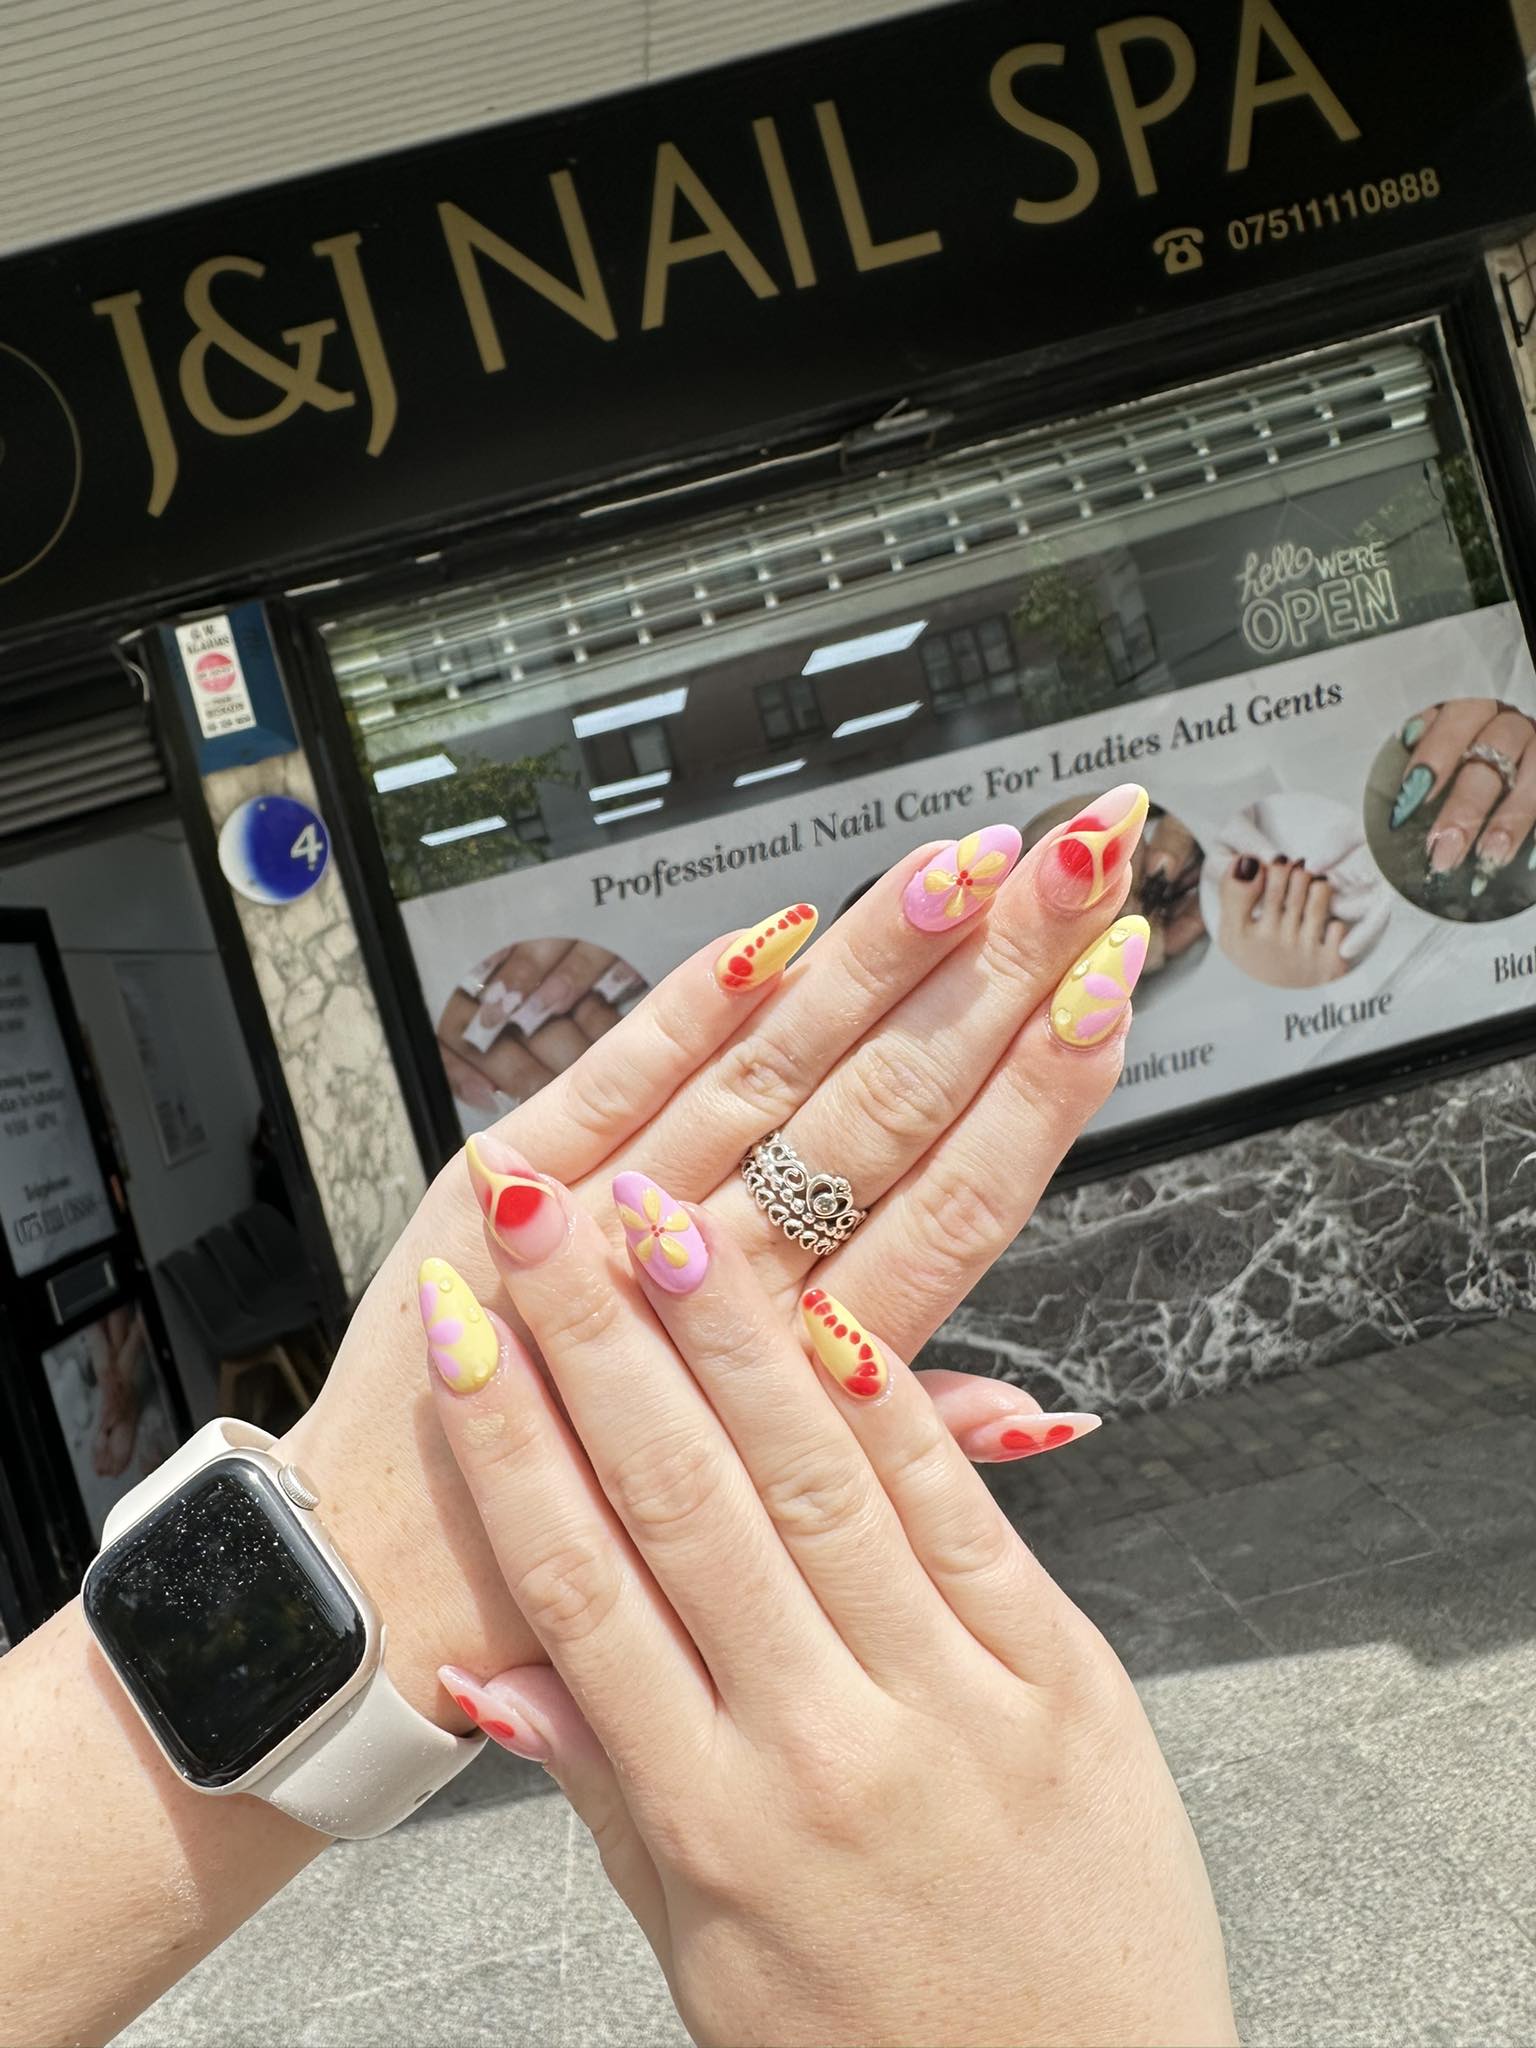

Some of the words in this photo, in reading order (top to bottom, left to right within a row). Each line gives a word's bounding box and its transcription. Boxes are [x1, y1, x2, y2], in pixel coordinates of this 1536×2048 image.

[1228, 167, 1440, 250] 07511110888
[92, 232, 398, 518] J&J
[437, 100, 942, 373] NAIL
[989, 0, 1362, 225] SPA
[1235, 543, 1313, 603] hello
[1242, 567, 1399, 655] OPEN
[591, 822, 803, 906] Professional
[811, 799, 886, 848] Nail
[895, 782, 974, 823] Care
[984, 764, 1039, 800] For
[1050, 731, 1161, 782] Ladies
[1170, 703, 1237, 750] And
[1246, 680, 1343, 725] Gents
[290, 823, 323, 871] 4
[1494, 946, 1536, 984] Bia
[1284, 991, 1393, 1041] Pedicure
[1117, 1042, 1214, 1088] anicure
